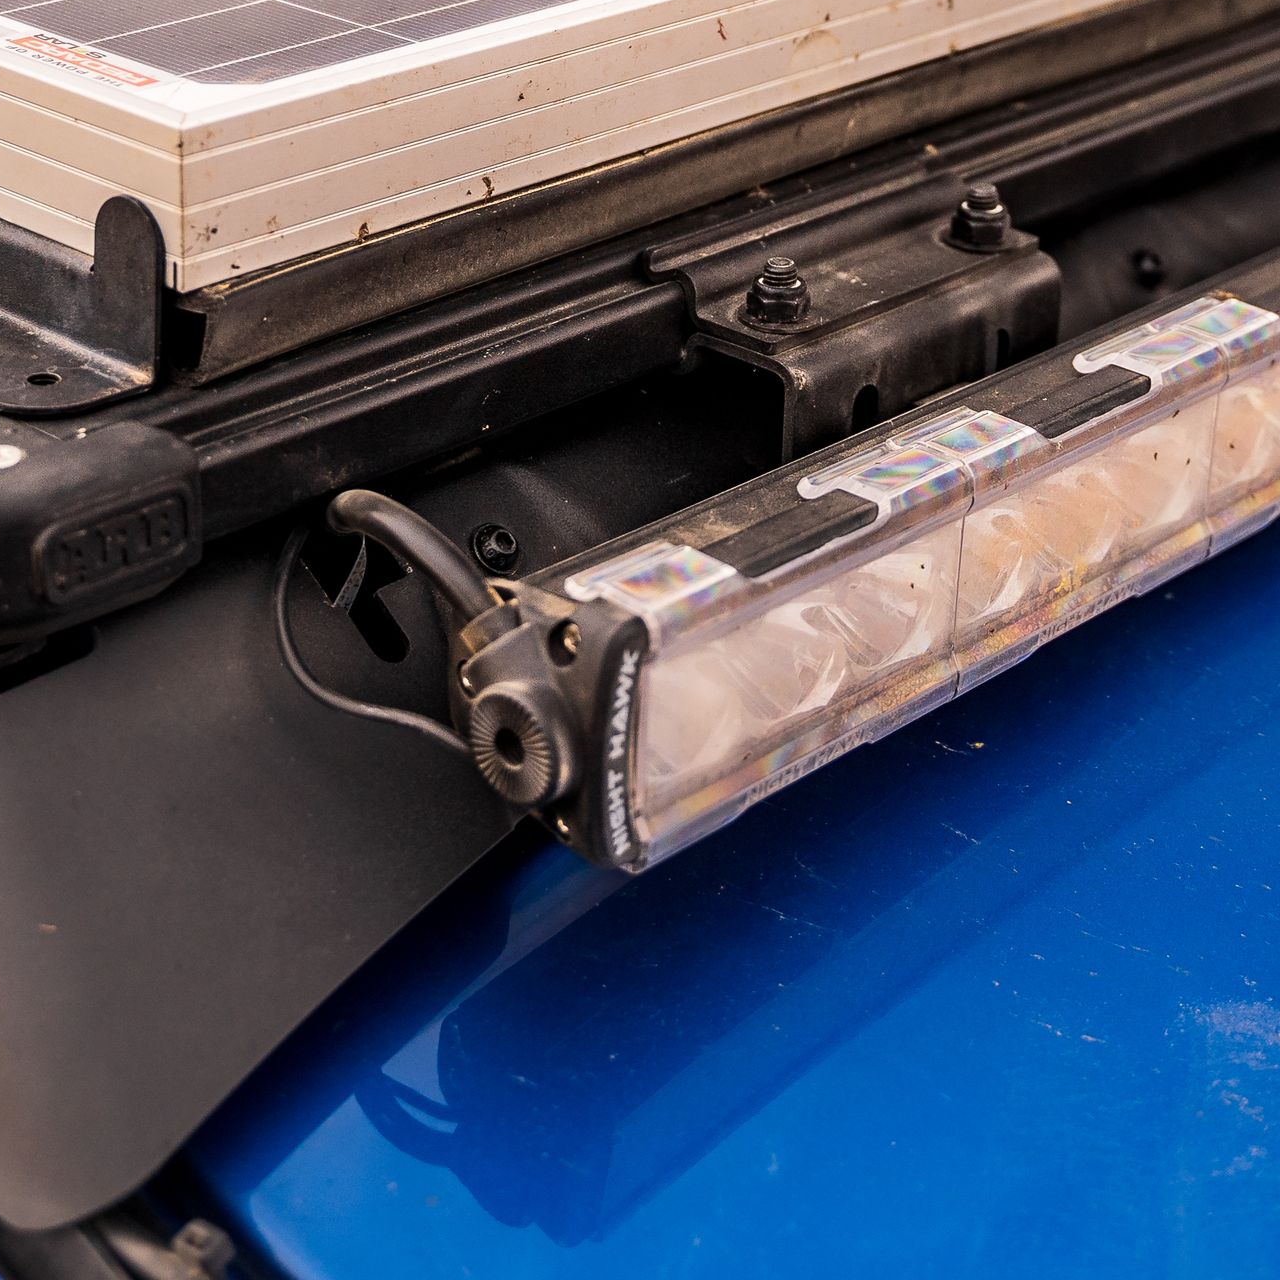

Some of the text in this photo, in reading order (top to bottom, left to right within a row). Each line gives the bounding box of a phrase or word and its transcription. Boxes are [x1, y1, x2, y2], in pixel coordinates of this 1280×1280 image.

[5, 45, 123, 88] THE POWER OF
[19, 38, 150, 85] REDARC
[49, 498, 183, 588] ARB
[607, 649, 640, 856] NIGHT HAWK
